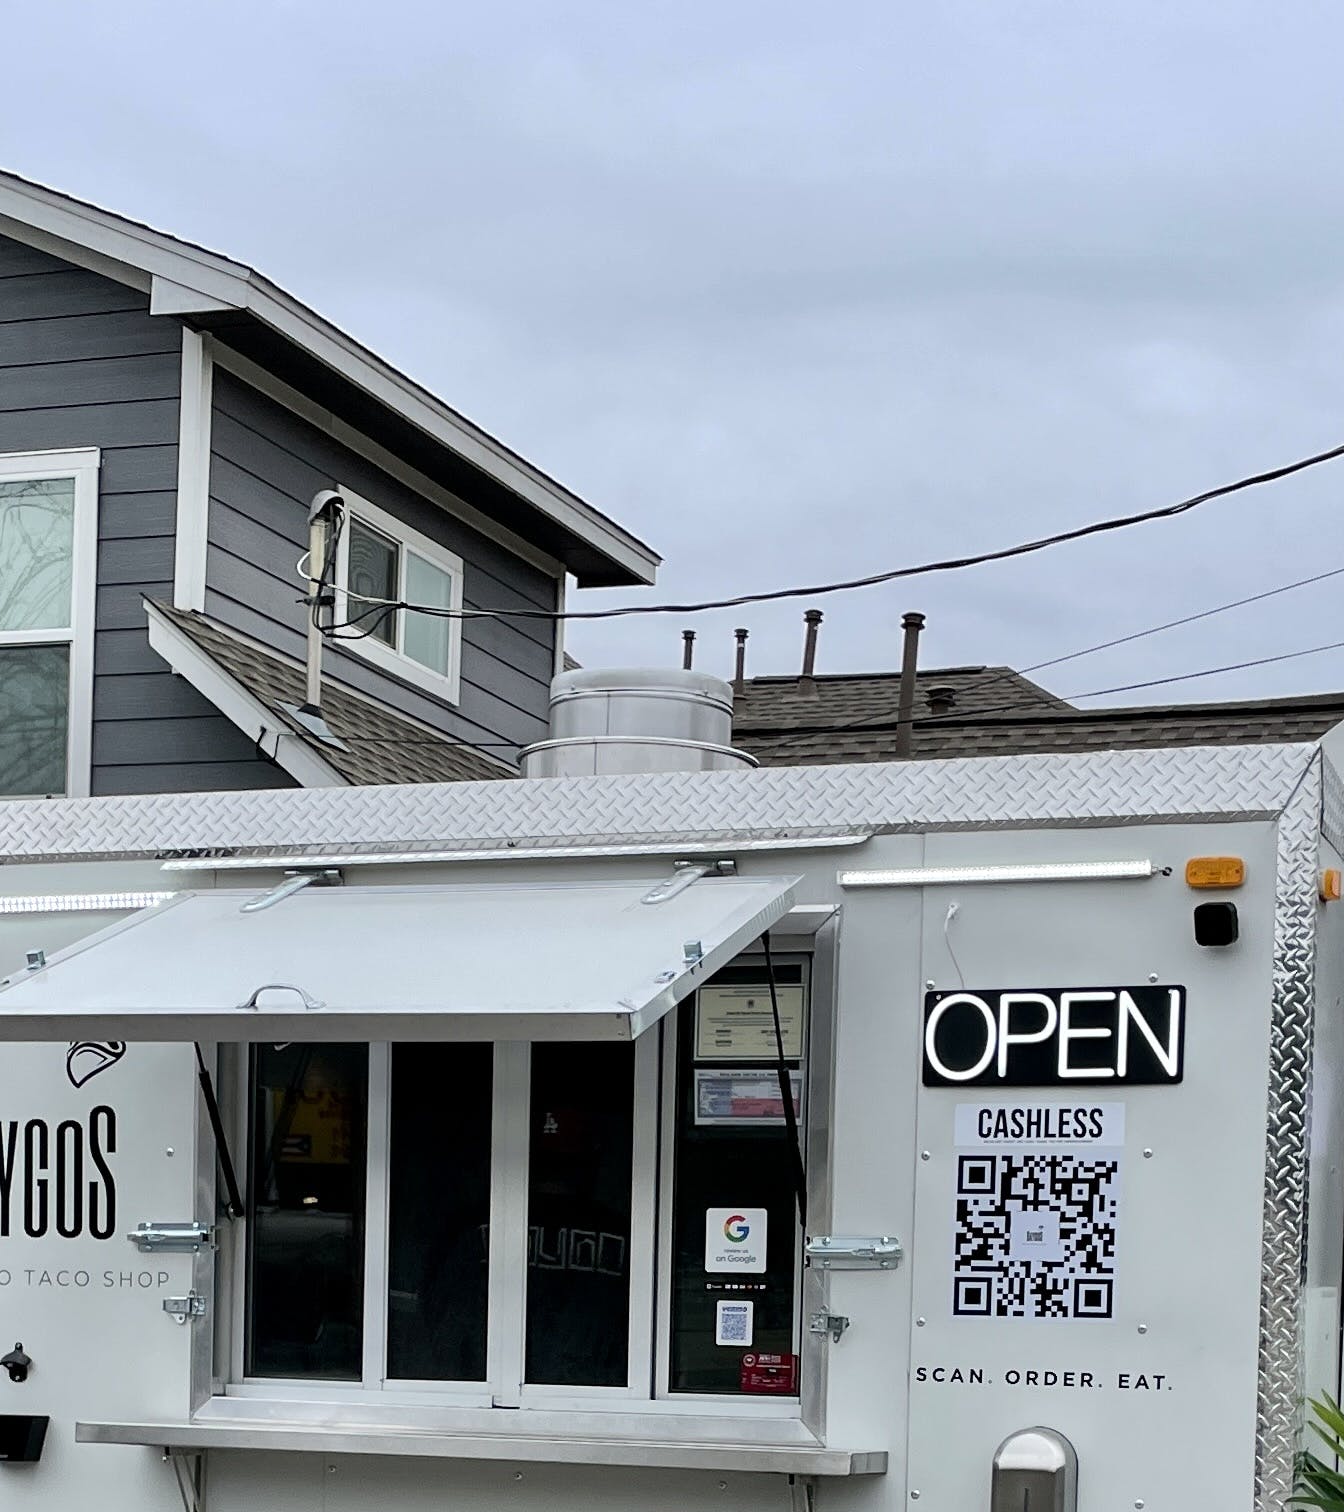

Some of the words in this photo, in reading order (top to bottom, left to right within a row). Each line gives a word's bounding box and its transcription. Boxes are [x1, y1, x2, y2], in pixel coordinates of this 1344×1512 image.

[925, 990, 1180, 1081] OPEN
[978, 1108, 1104, 1139] CASHLESS
[727, 1254, 757, 1264] Google
[23, 1269, 90, 1287] TACO
[103, 1270, 170, 1289] SHOP
[916, 1366, 993, 1385] SCAN.
[1005, 1369, 1103, 1389] ORDER.
[1118, 1373, 1173, 1391] EAT.
